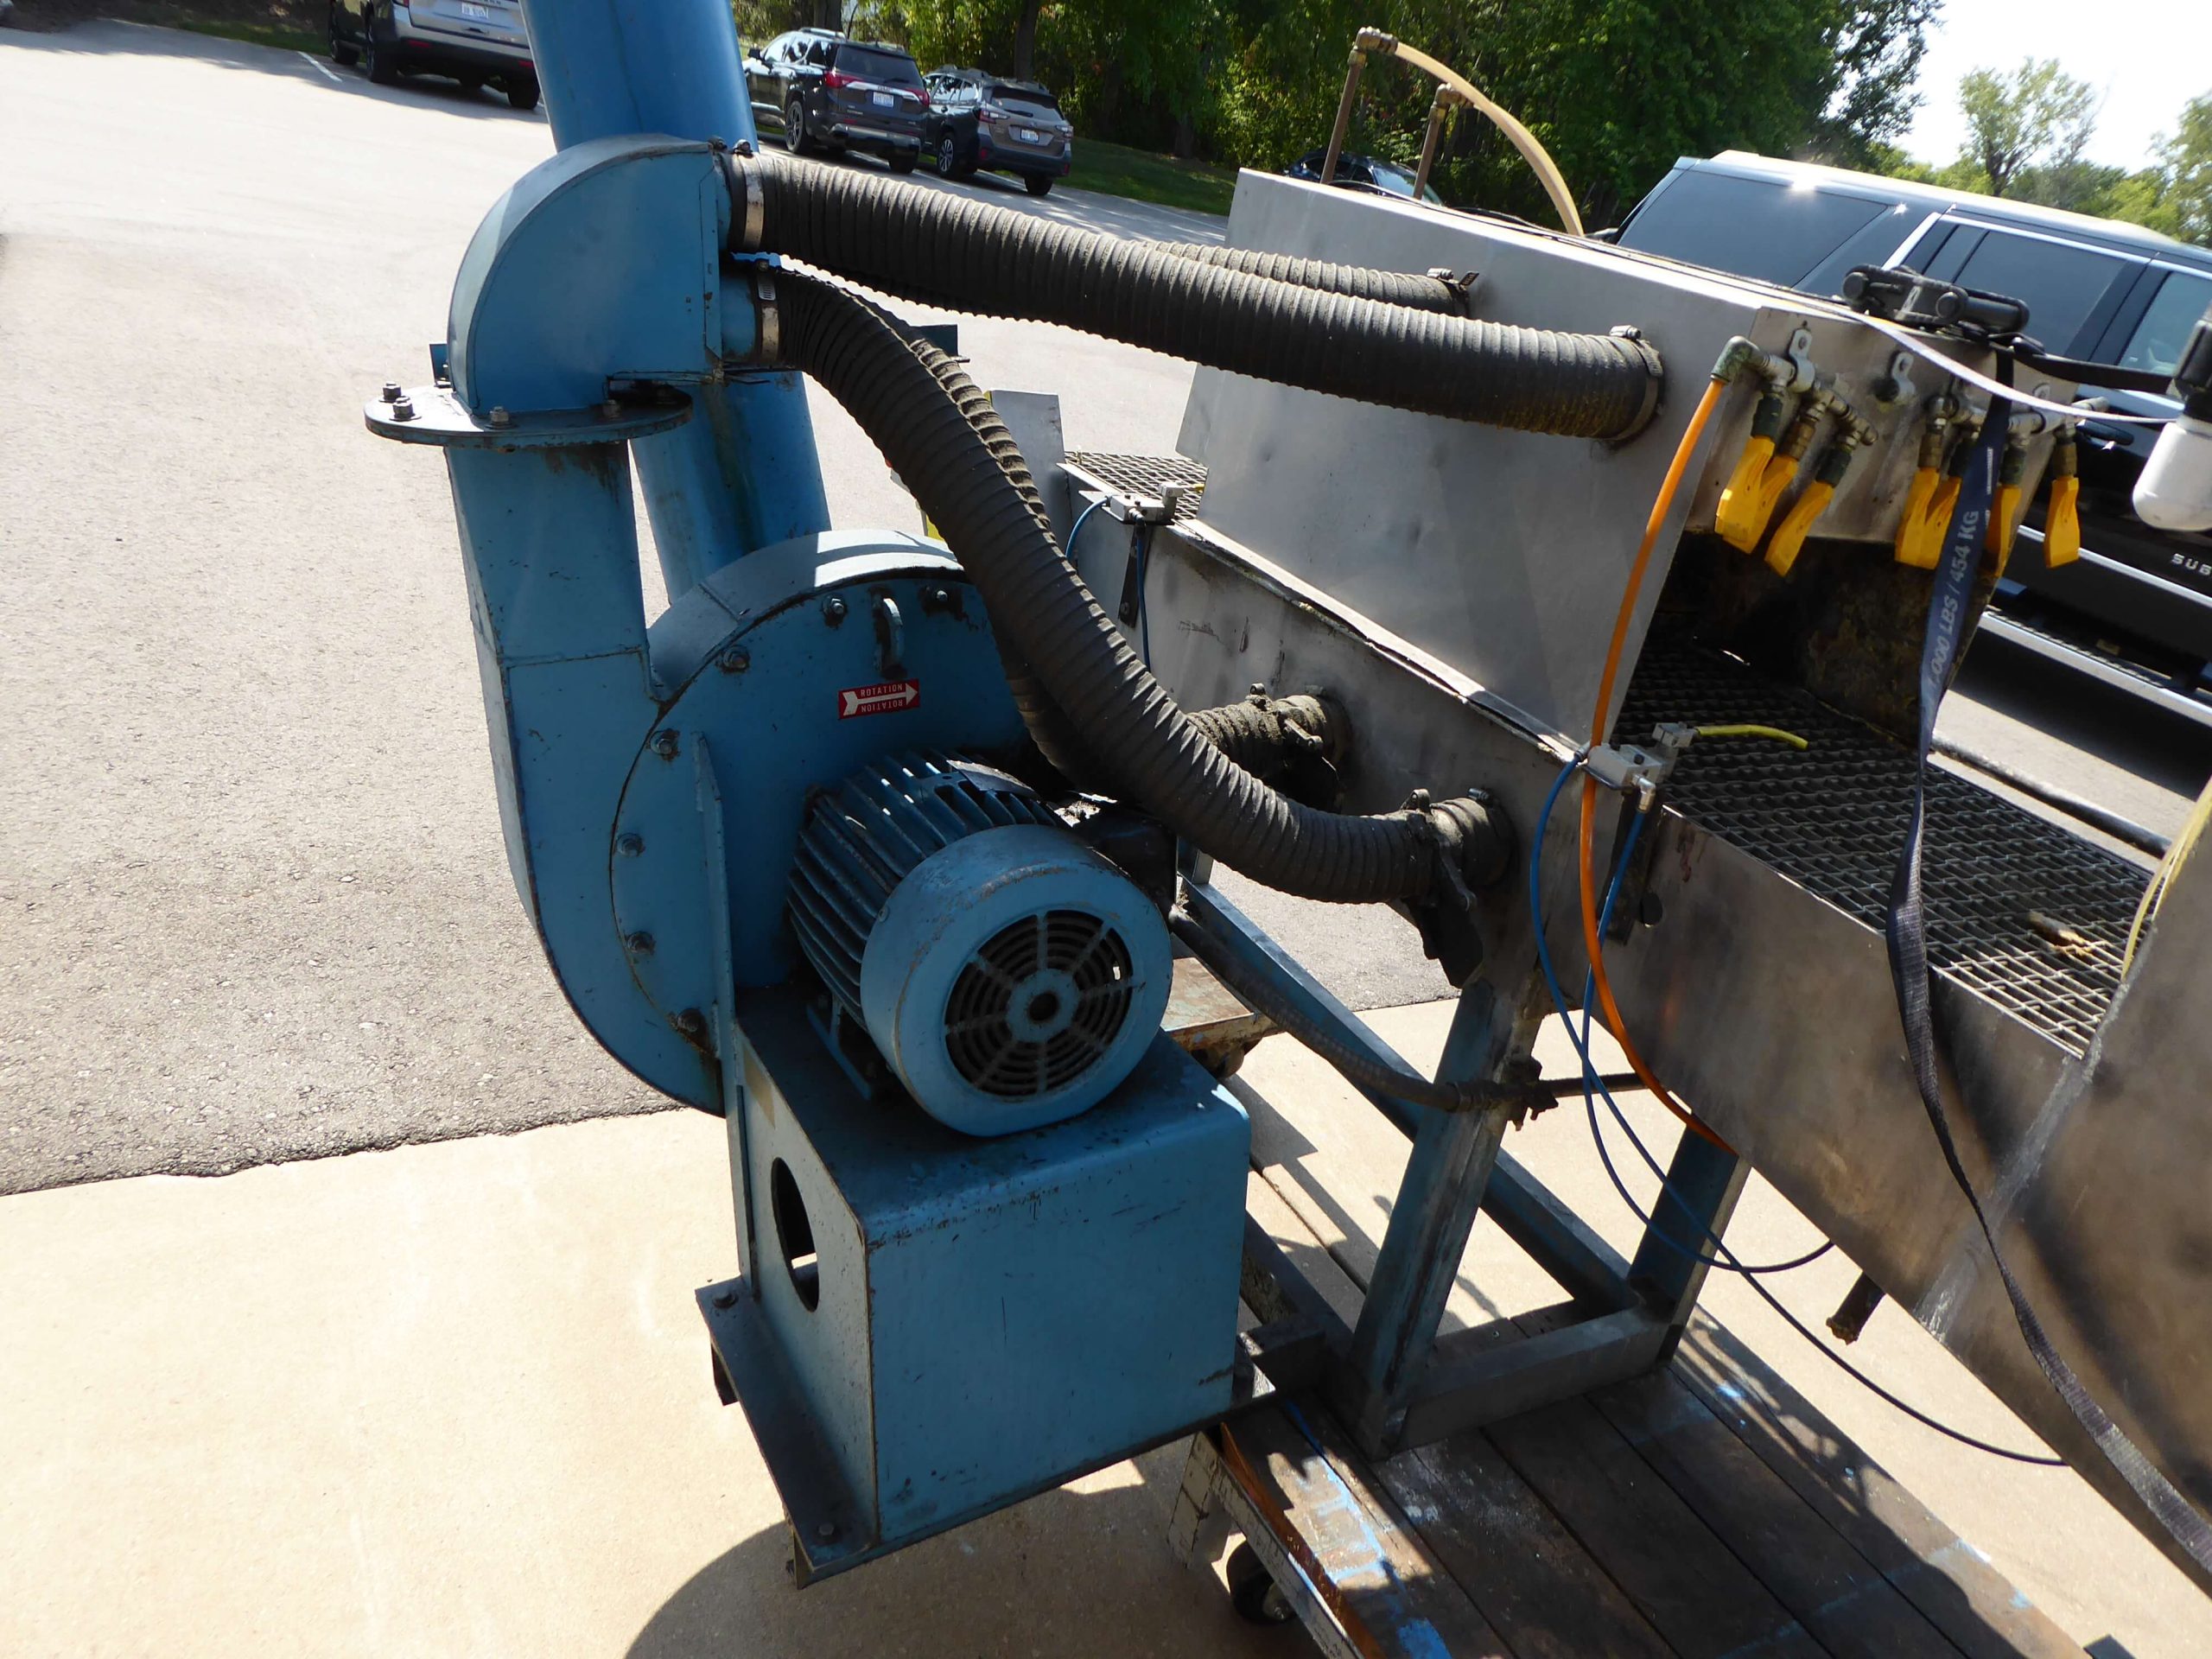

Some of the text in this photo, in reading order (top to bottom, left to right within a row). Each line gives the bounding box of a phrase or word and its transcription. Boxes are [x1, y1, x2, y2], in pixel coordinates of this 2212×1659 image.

[1957, 511, 1980, 539] KG
[1949, 545, 1971, 582] 454
[1946, 582, 1961, 594] /
[1939, 594, 1958, 636] LBS
[860, 683, 903, 697] ROTATION
[860, 699, 904, 713] ROTATION
